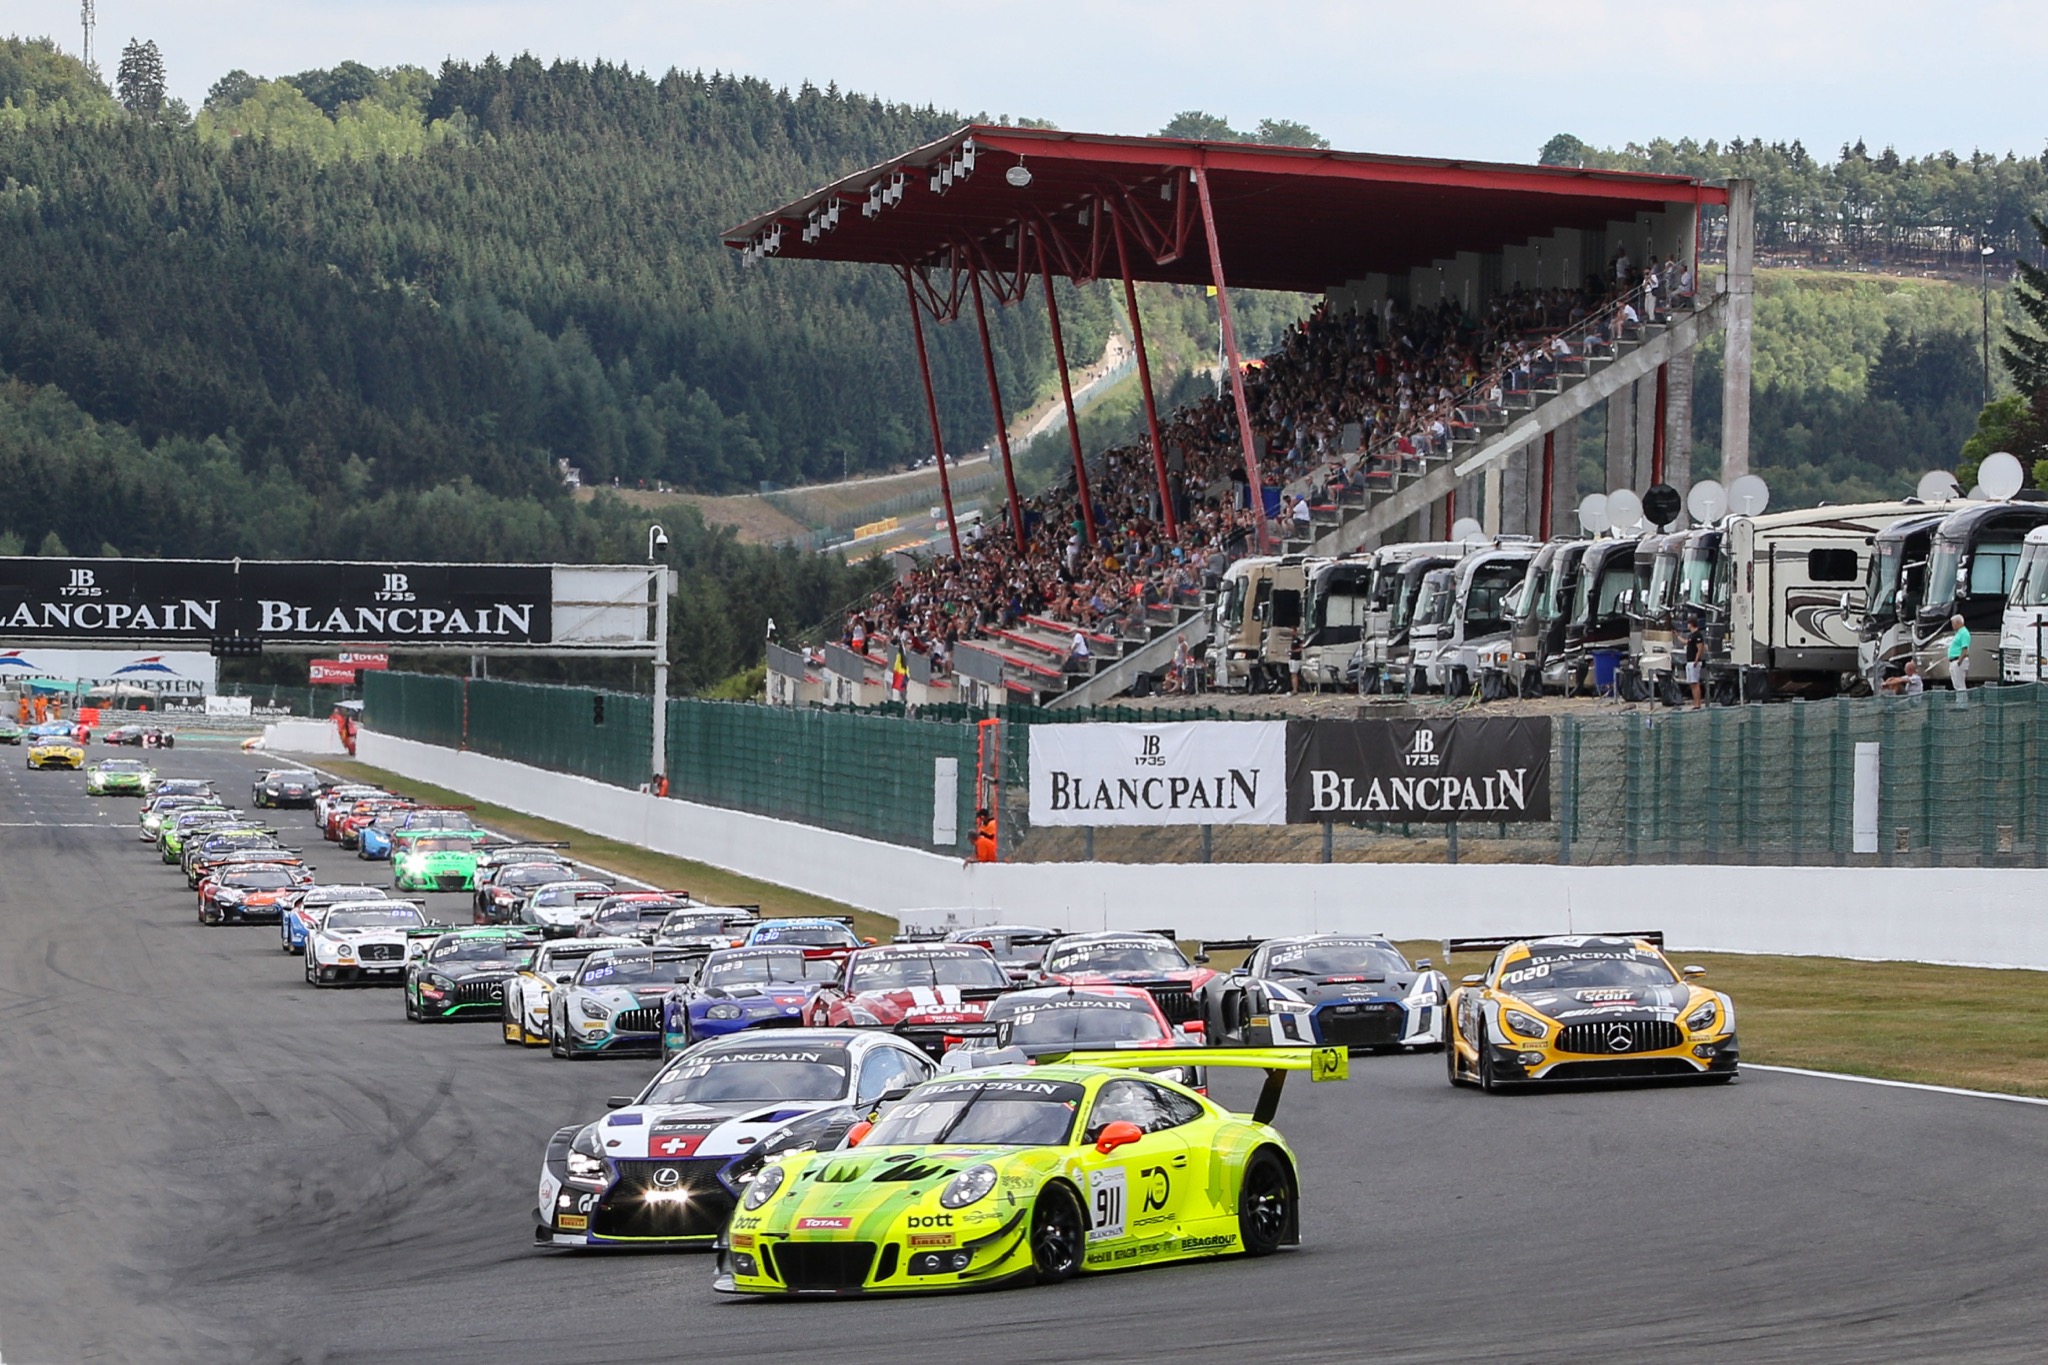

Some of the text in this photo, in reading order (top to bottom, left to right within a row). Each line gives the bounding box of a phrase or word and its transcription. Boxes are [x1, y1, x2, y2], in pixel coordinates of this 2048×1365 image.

[60, 587, 102, 596] 1735
[374, 592, 416, 601] 1735
[0, 600, 221, 630] ANCPAIN
[257, 600, 535, 634] BLANCPAIN
[1134, 755, 1166, 766] 1735
[1405, 754, 1440, 766] 1735
[1050, 768, 1260, 811] BLANCPAIN
[1310, 768, 1527, 812] BLANCPAIN
[1531, 952, 1638, 966] BLANCPAIN
[712, 960, 744, 973] 023
[1510, 964, 1550, 984] 020
[904, 1003, 984, 1017] MOTUL
[1014, 1000, 1132, 1014] BLANCPAIN
[687, 1051, 821, 1066] BLANCPAIN
[1096, 1186, 1120, 1228] 911
[734, 1216, 762, 1229] bott
[805, 1218, 843, 1227] TOTAL
[908, 1214, 954, 1228] bott
[1181, 1234, 1237, 1249] BESAGROUP
